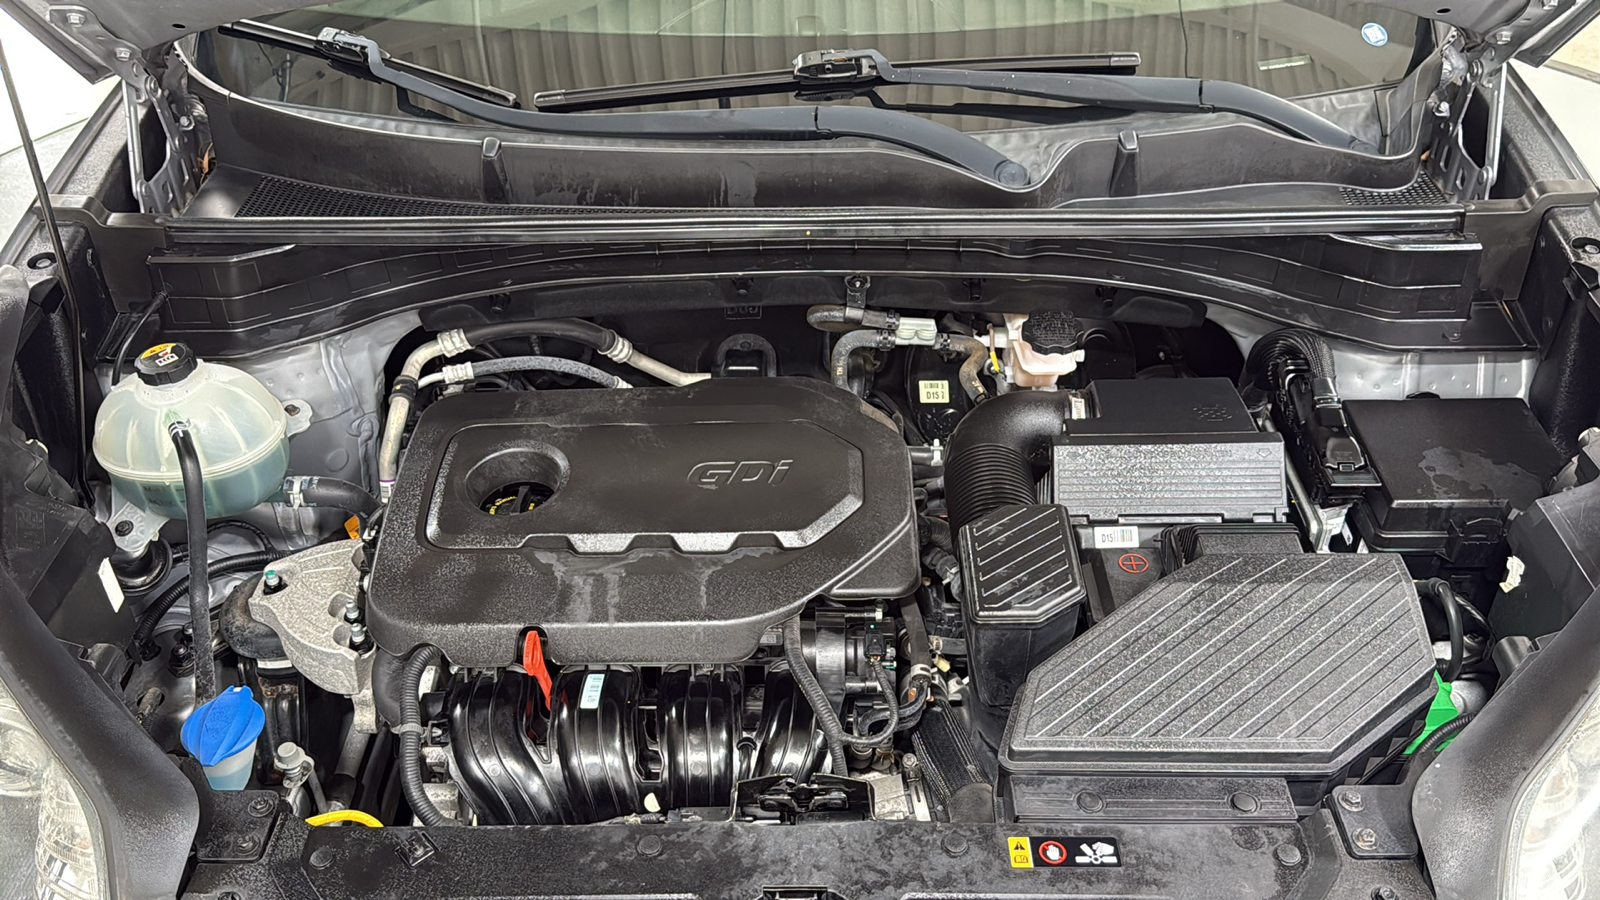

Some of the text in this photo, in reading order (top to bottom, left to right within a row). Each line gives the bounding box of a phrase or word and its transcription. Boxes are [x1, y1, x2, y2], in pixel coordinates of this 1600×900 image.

[926, 391, 940, 400] D15
[687, 459, 794, 487] GDi
[1101, 533, 1114, 543] D15
